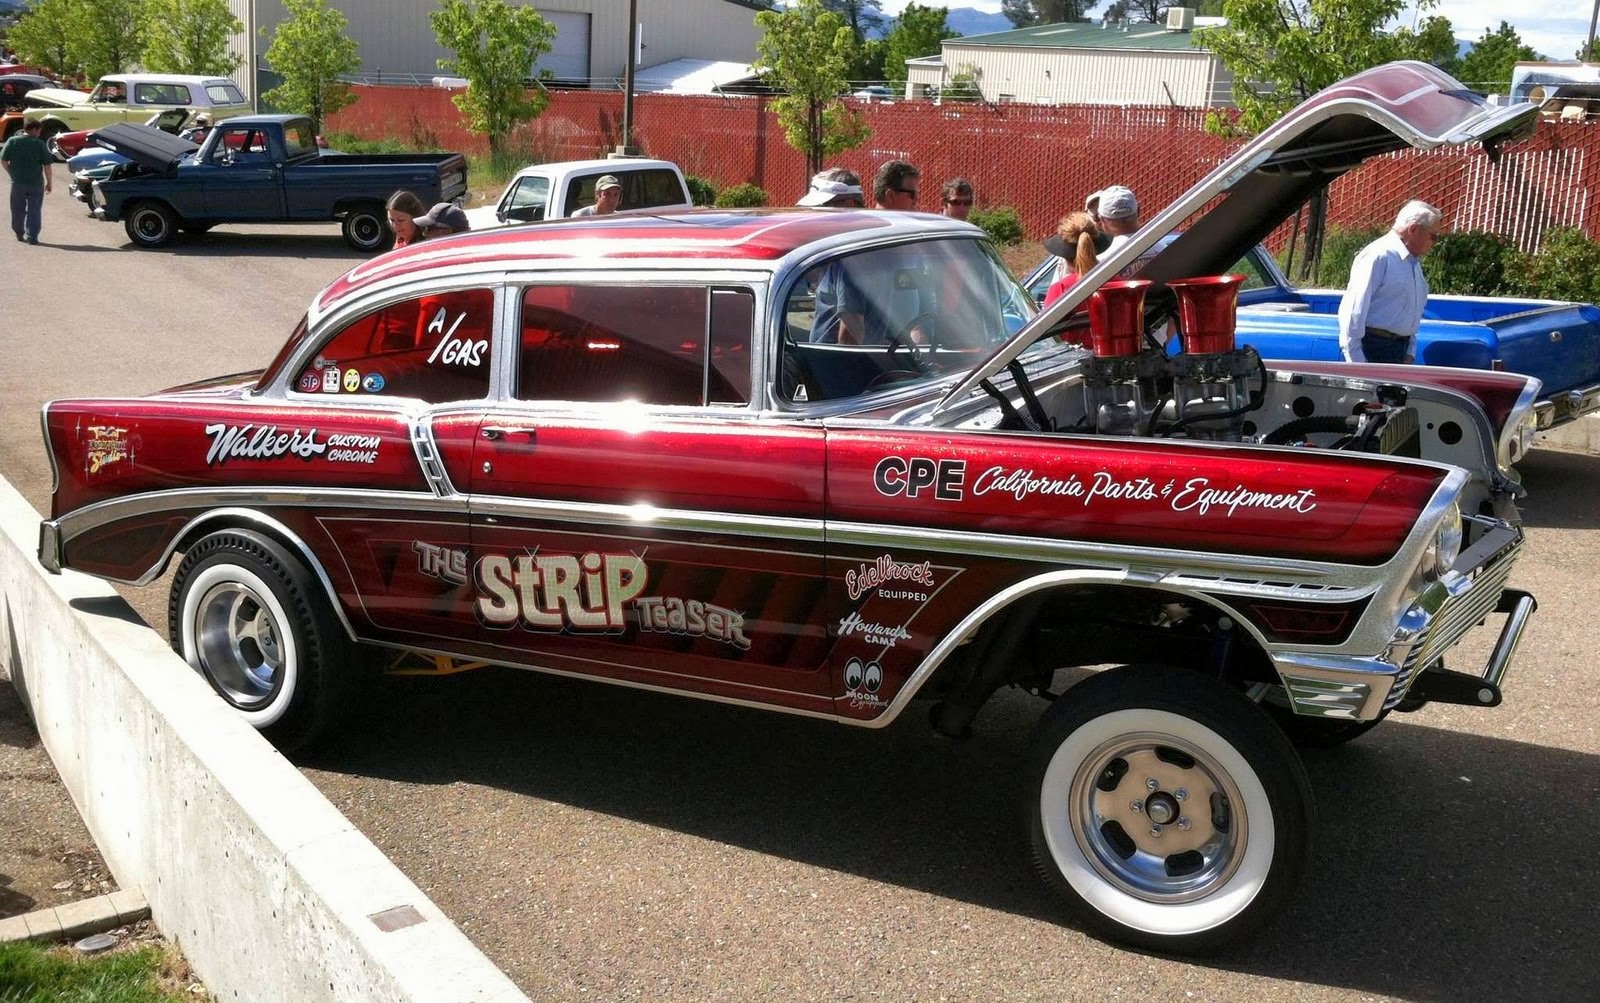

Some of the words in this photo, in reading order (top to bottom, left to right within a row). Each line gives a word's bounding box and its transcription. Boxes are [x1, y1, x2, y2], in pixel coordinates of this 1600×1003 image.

[302, 374, 318, 388] STP
[205, 423, 327, 465] Walkers
[327, 433, 381, 449] CUSTOM
[327, 449, 379, 464] CHROME
[873, 456, 967, 501] CPE
[973, 466, 1085, 500] California
[1084, 472, 1158, 506] Parts
[1161, 478, 1175, 499] &
[1171, 478, 1317, 517] Equipment
[845, 554, 935, 600] Edelbrock
[878, 589, 928, 601] EQUIPPED
[837, 611, 913, 641] Howards
[864, 634, 896, 648] CAMS
[846, 690, 879, 702] MOON
